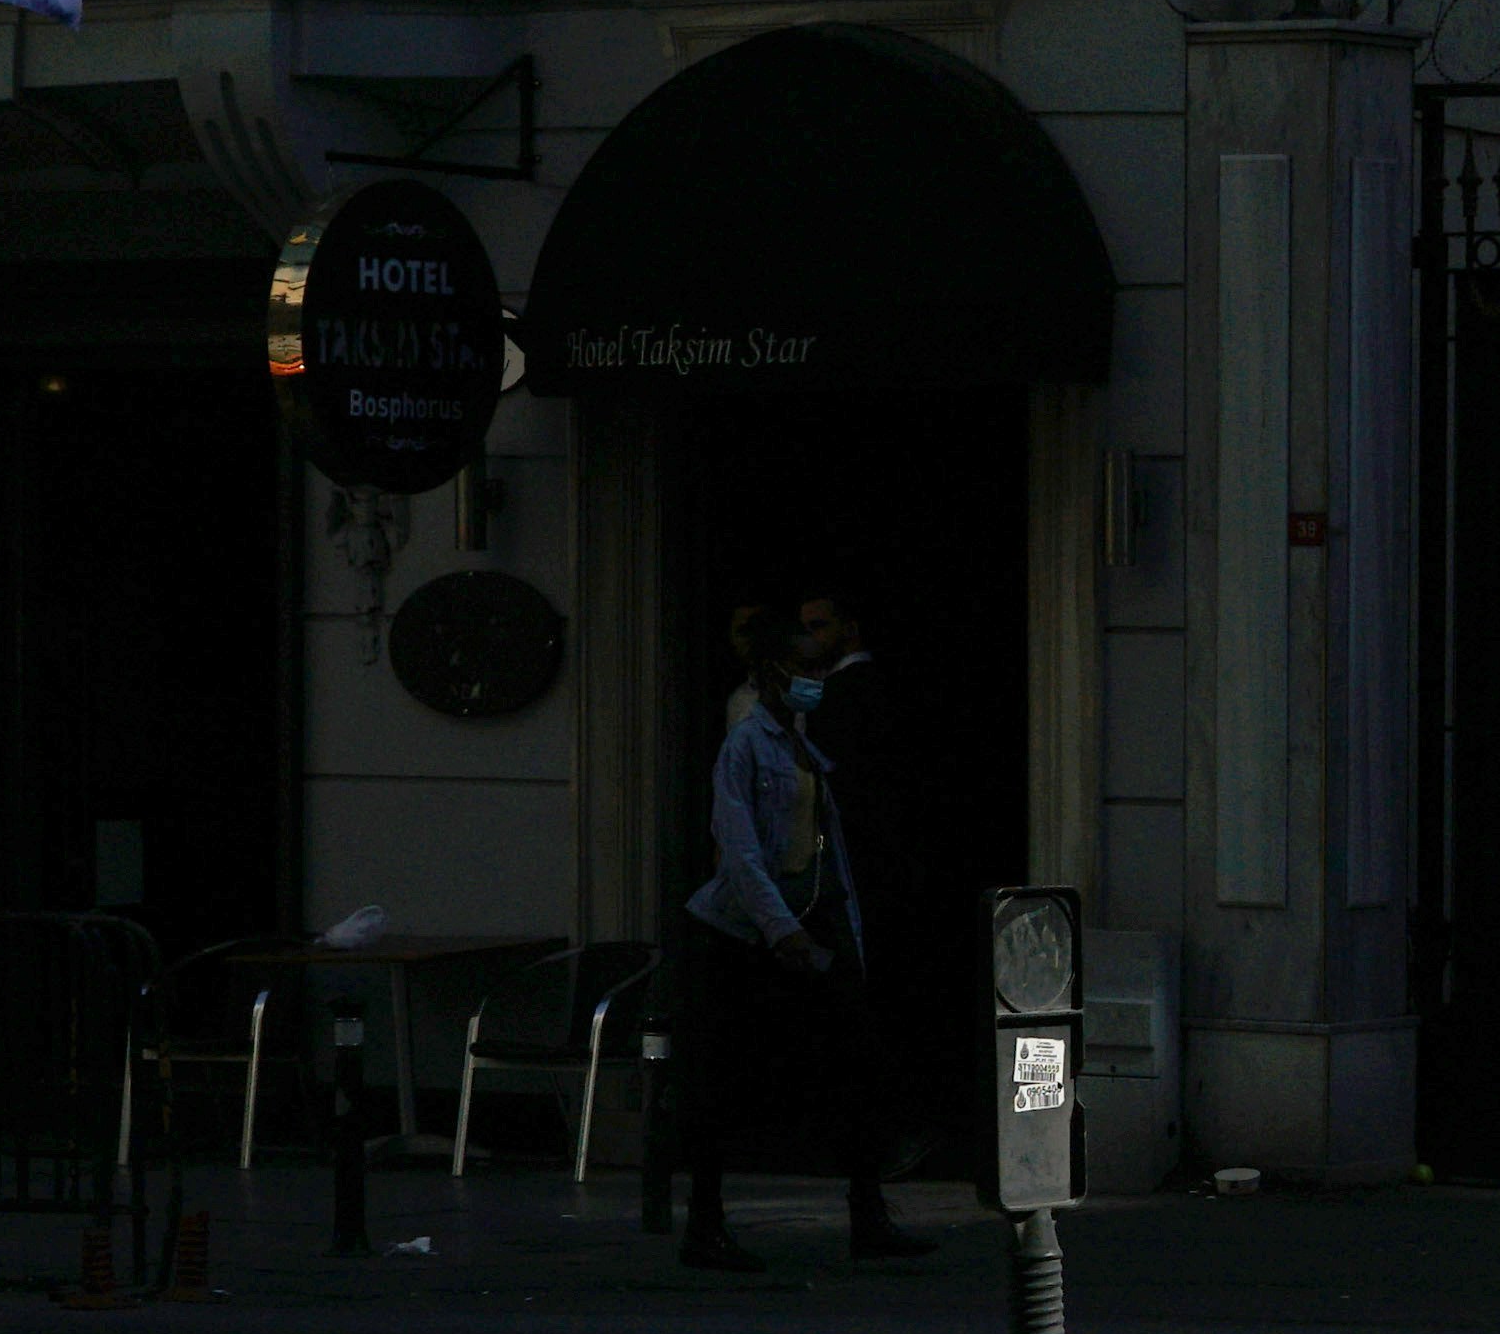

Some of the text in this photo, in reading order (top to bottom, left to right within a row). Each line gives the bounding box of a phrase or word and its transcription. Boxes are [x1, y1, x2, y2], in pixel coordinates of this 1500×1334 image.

[359, 256, 455, 296] HOTEL
[566, 322, 818, 376] Hotel Taksim Star
[349, 389, 464, 424] Bosphorus
